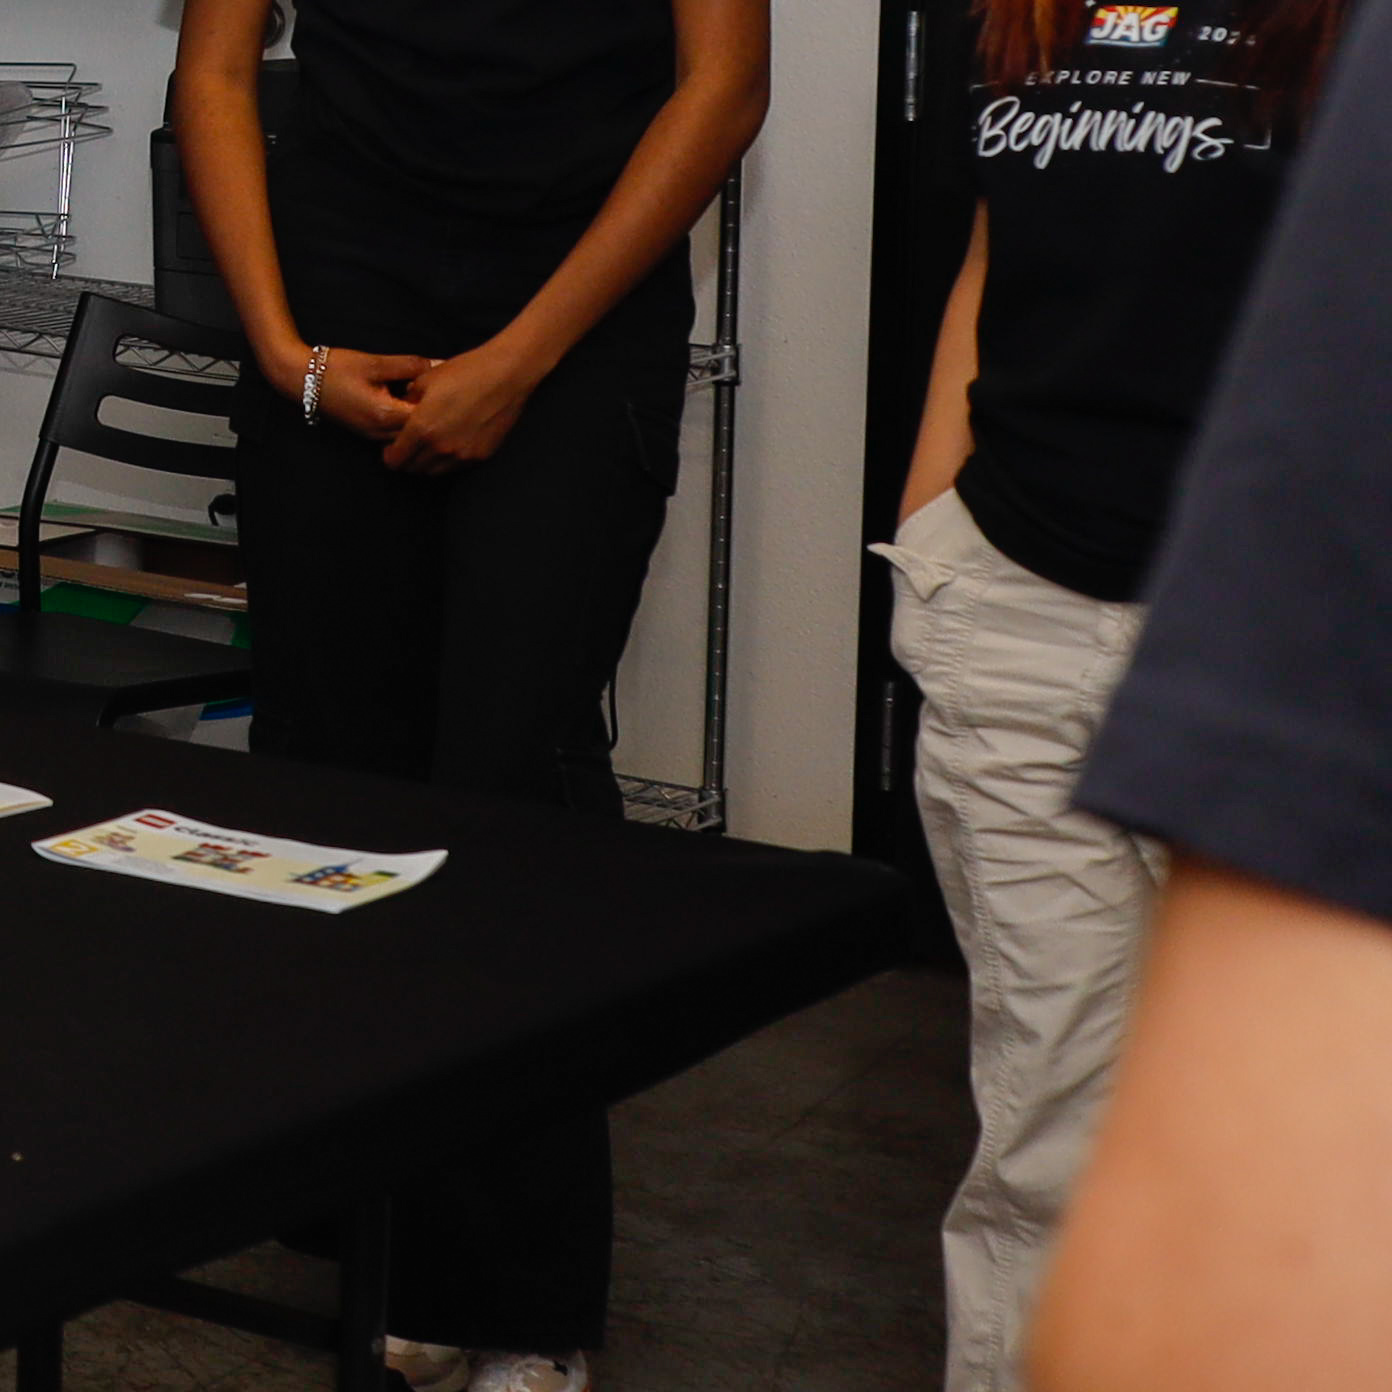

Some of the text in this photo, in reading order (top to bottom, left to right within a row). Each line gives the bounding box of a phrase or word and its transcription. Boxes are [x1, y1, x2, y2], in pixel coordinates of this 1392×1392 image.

[1089, 12, 1172, 43] JAG
[1024, 70, 1192, 86] EXPLORE NEW
[977, 96, 1235, 174] Beginnings
